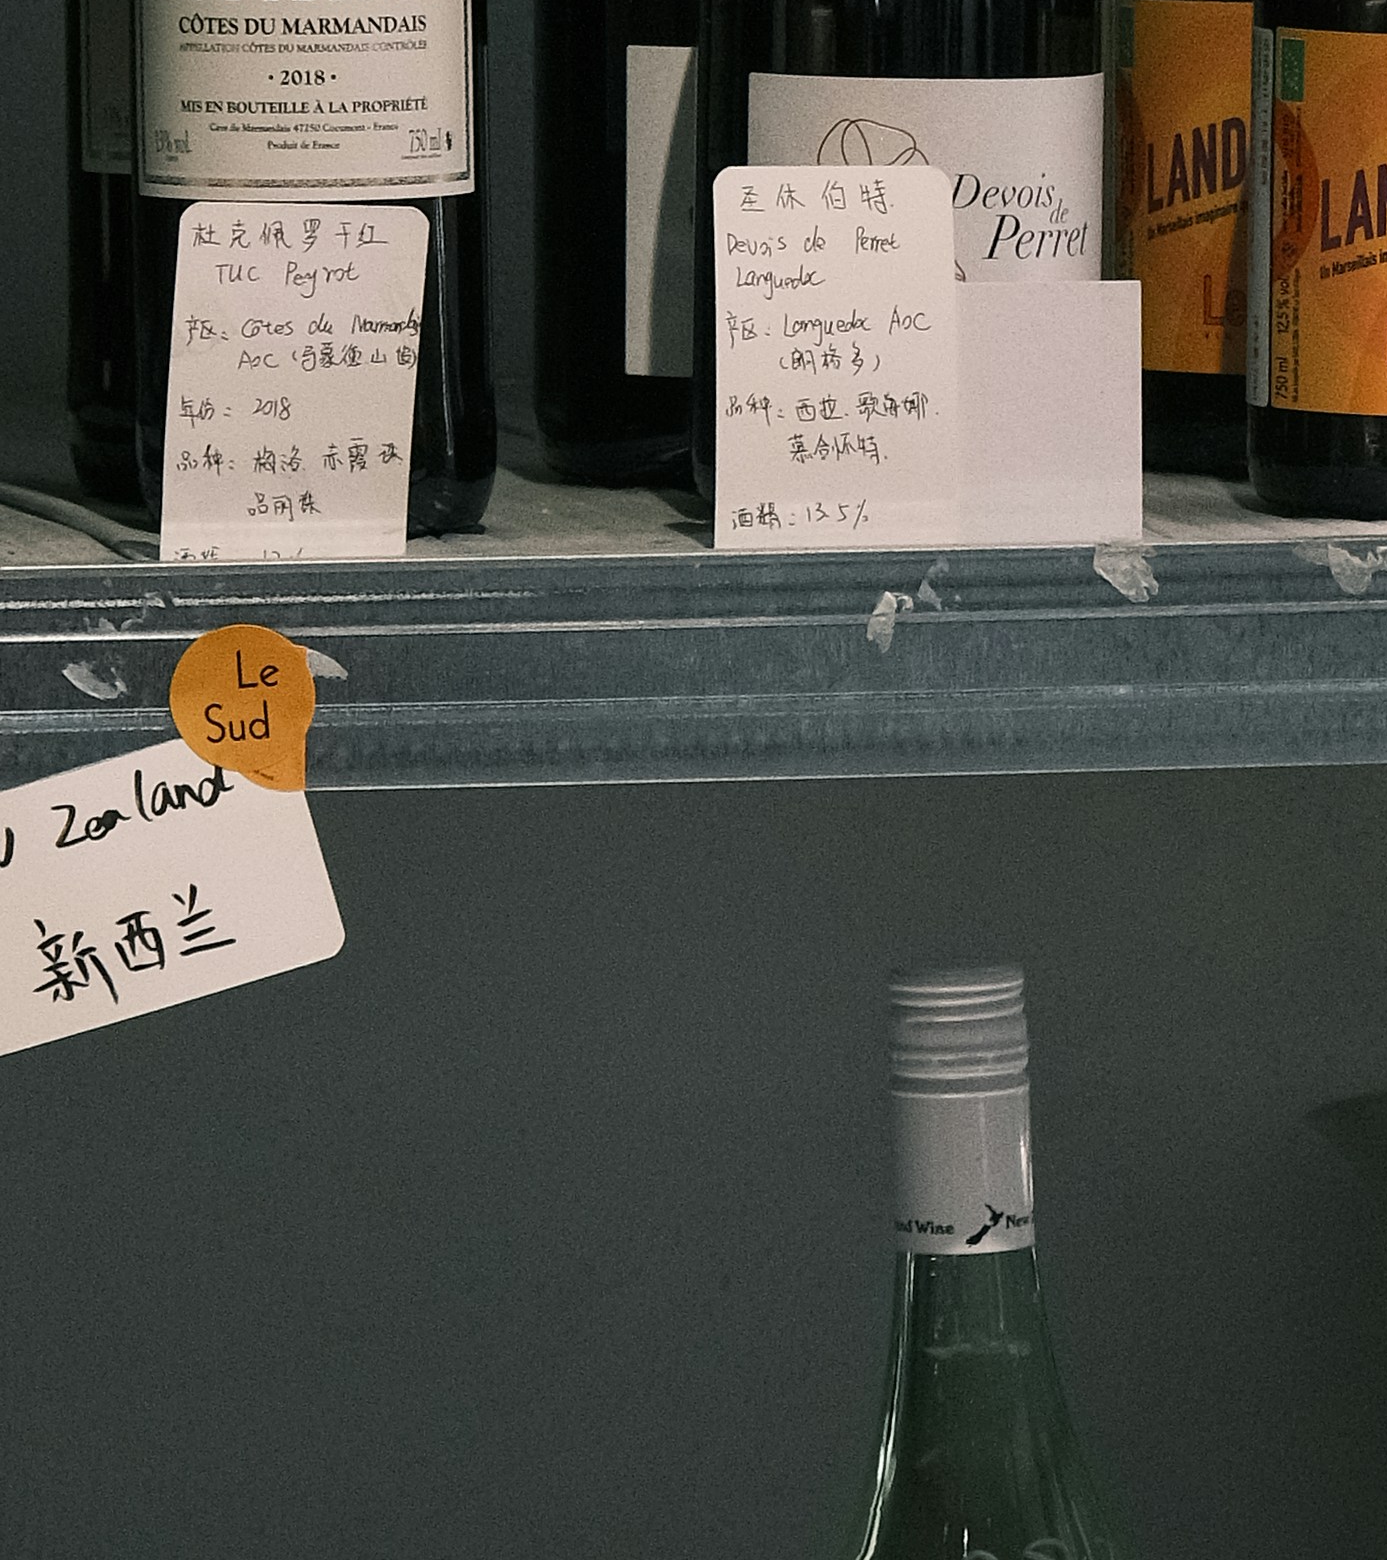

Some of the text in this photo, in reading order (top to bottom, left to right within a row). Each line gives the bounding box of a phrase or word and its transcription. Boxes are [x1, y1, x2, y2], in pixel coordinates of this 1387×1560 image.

[178, 12, 427, 36] CÔTES DU MARMANDAIS
[279, 68, 326, 87] 2018
[180, 96, 428, 115] MIS EN BOUTEILLE À LA PROPRIÉTÉ
[952, 172, 1069, 224] Devois de
[981, 214, 1089, 260] Perret
[215, 263, 261, 285] TUC
[1276, 356, 1289, 373] ml
[1274, 376, 1289, 400] 750
[251, 397, 292, 421] 2018
[235, 649, 280, 690] Le
[203, 699, 271, 745] Sud
[51, 764, 236, 850] Zealand
[32, 883, 238, 1005] 新西兰
[915, 1219, 956, 1236] Wine
